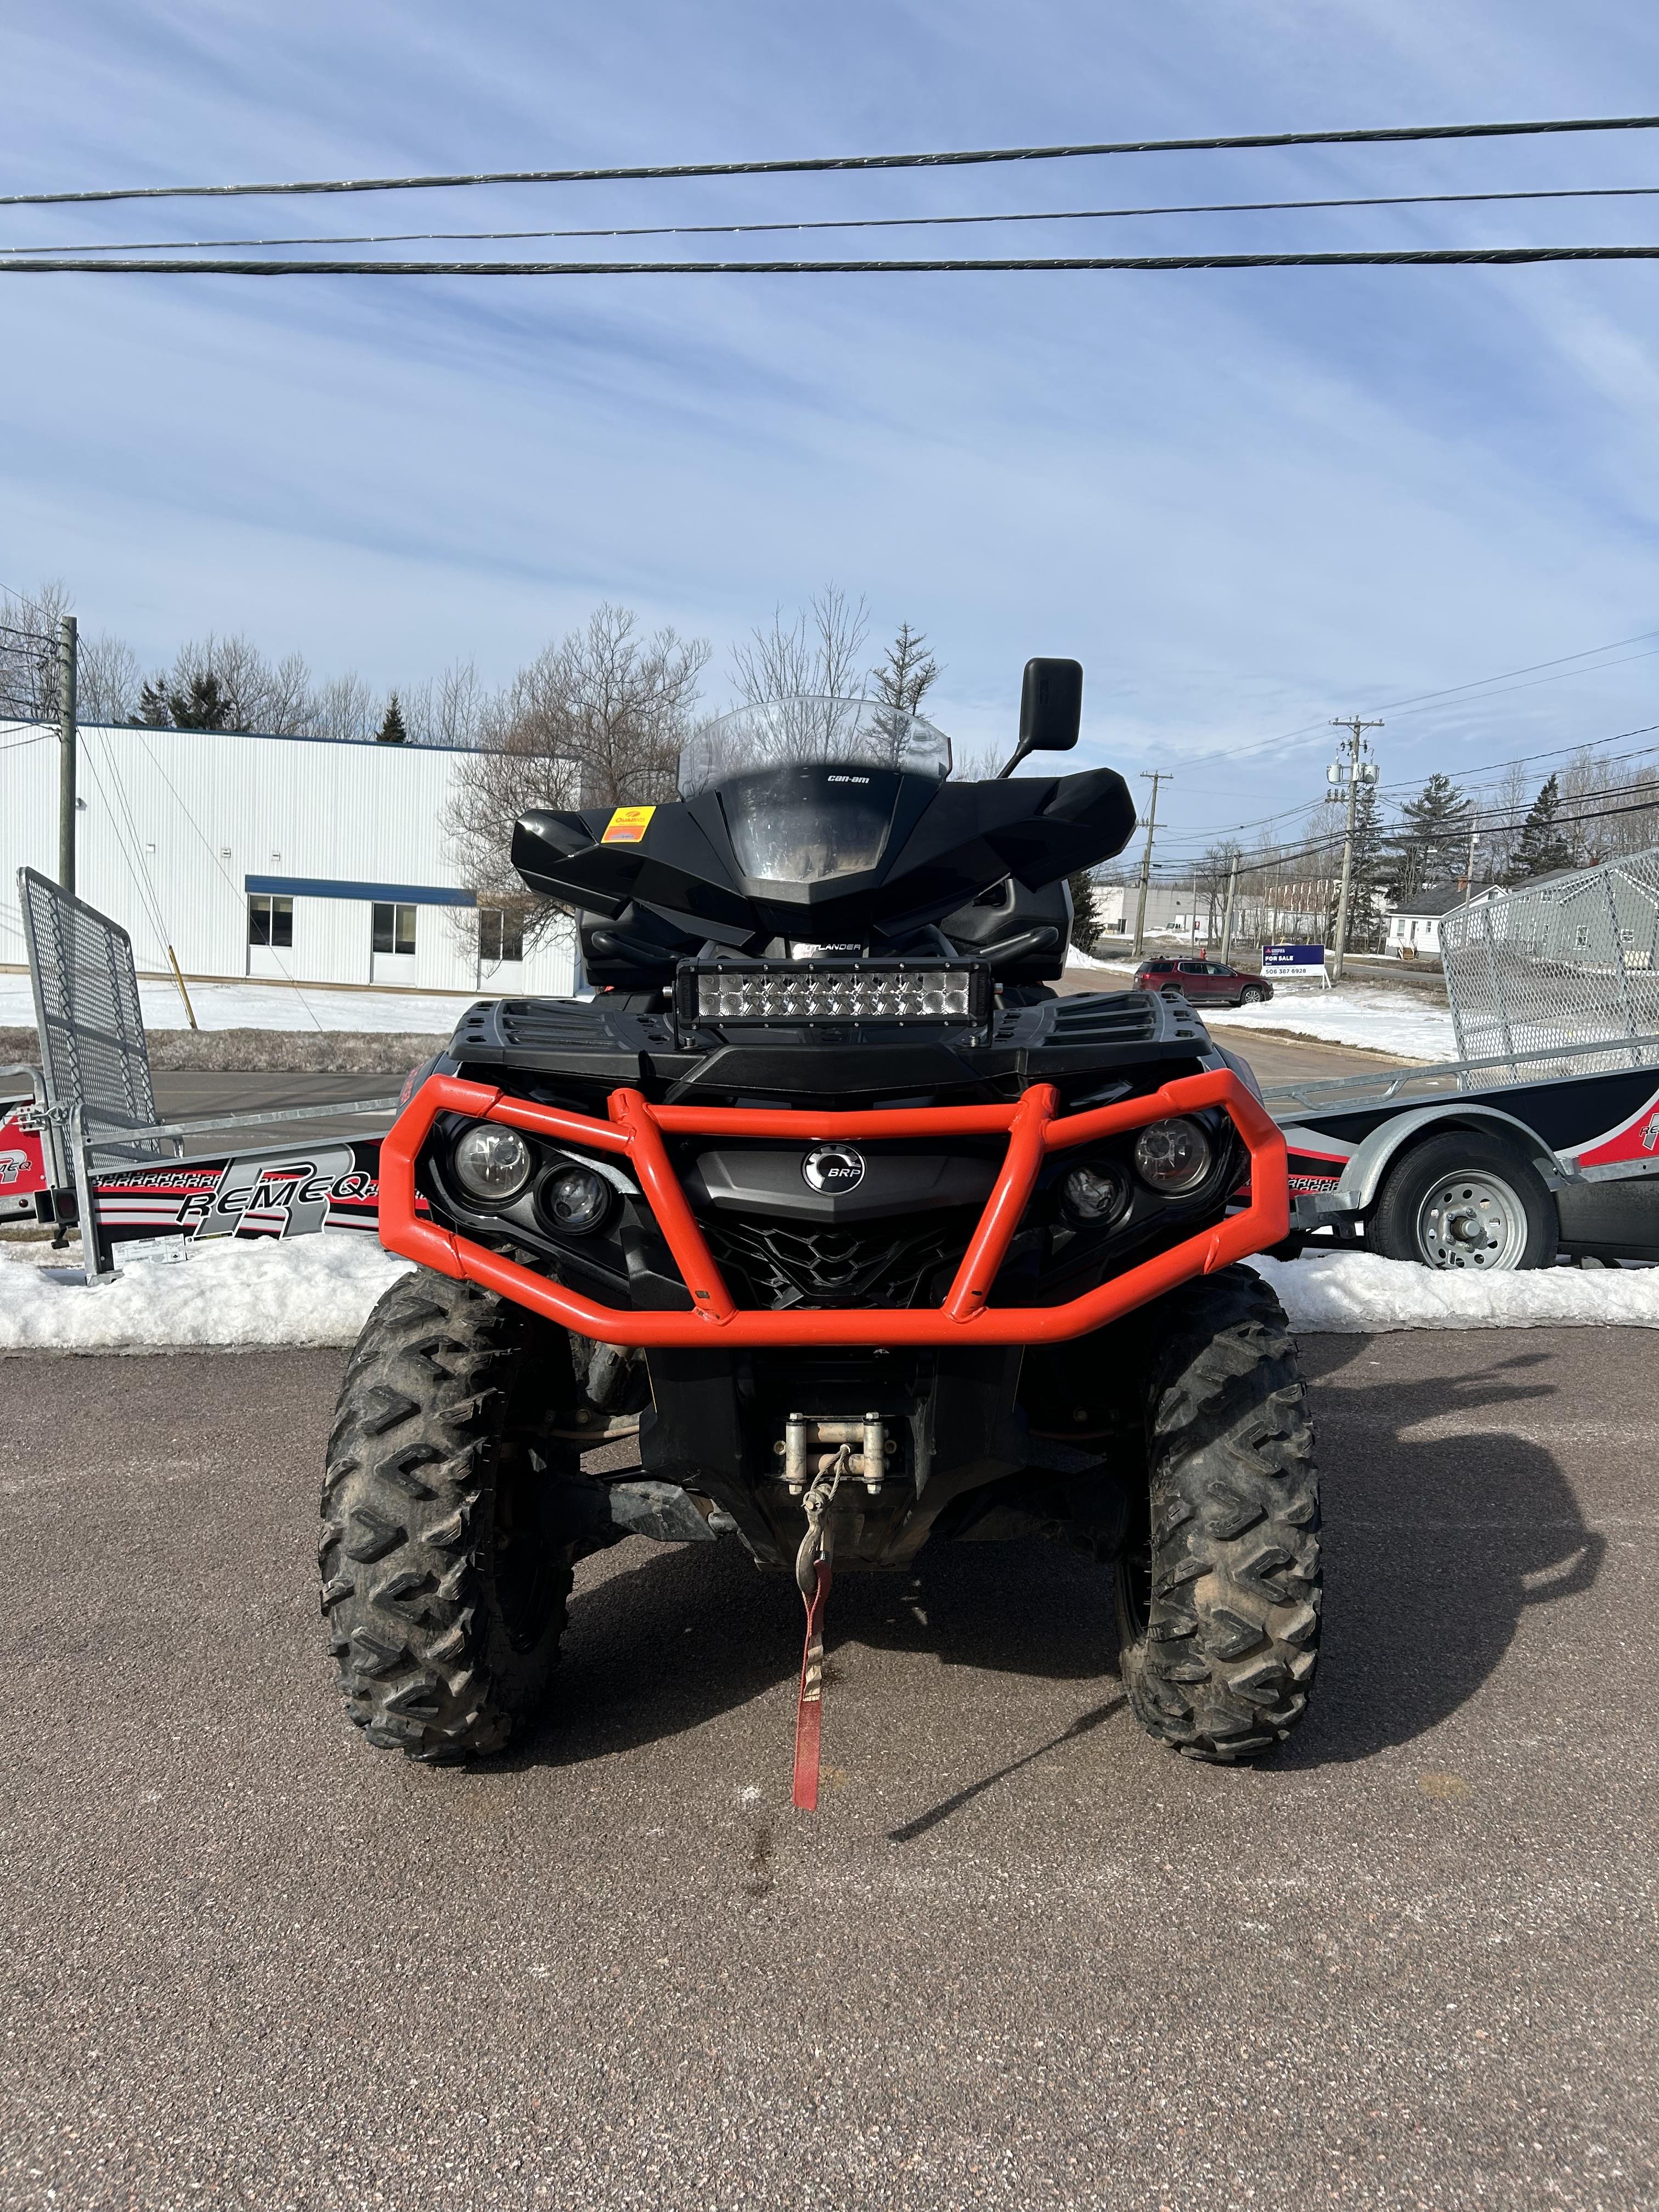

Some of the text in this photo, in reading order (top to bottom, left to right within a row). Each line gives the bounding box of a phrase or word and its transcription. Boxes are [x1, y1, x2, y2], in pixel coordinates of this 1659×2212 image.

[827, 775, 870, 783] can-am
[828, 1168, 861, 1177] BRP
[175, 1171, 370, 1226] REMEQ
